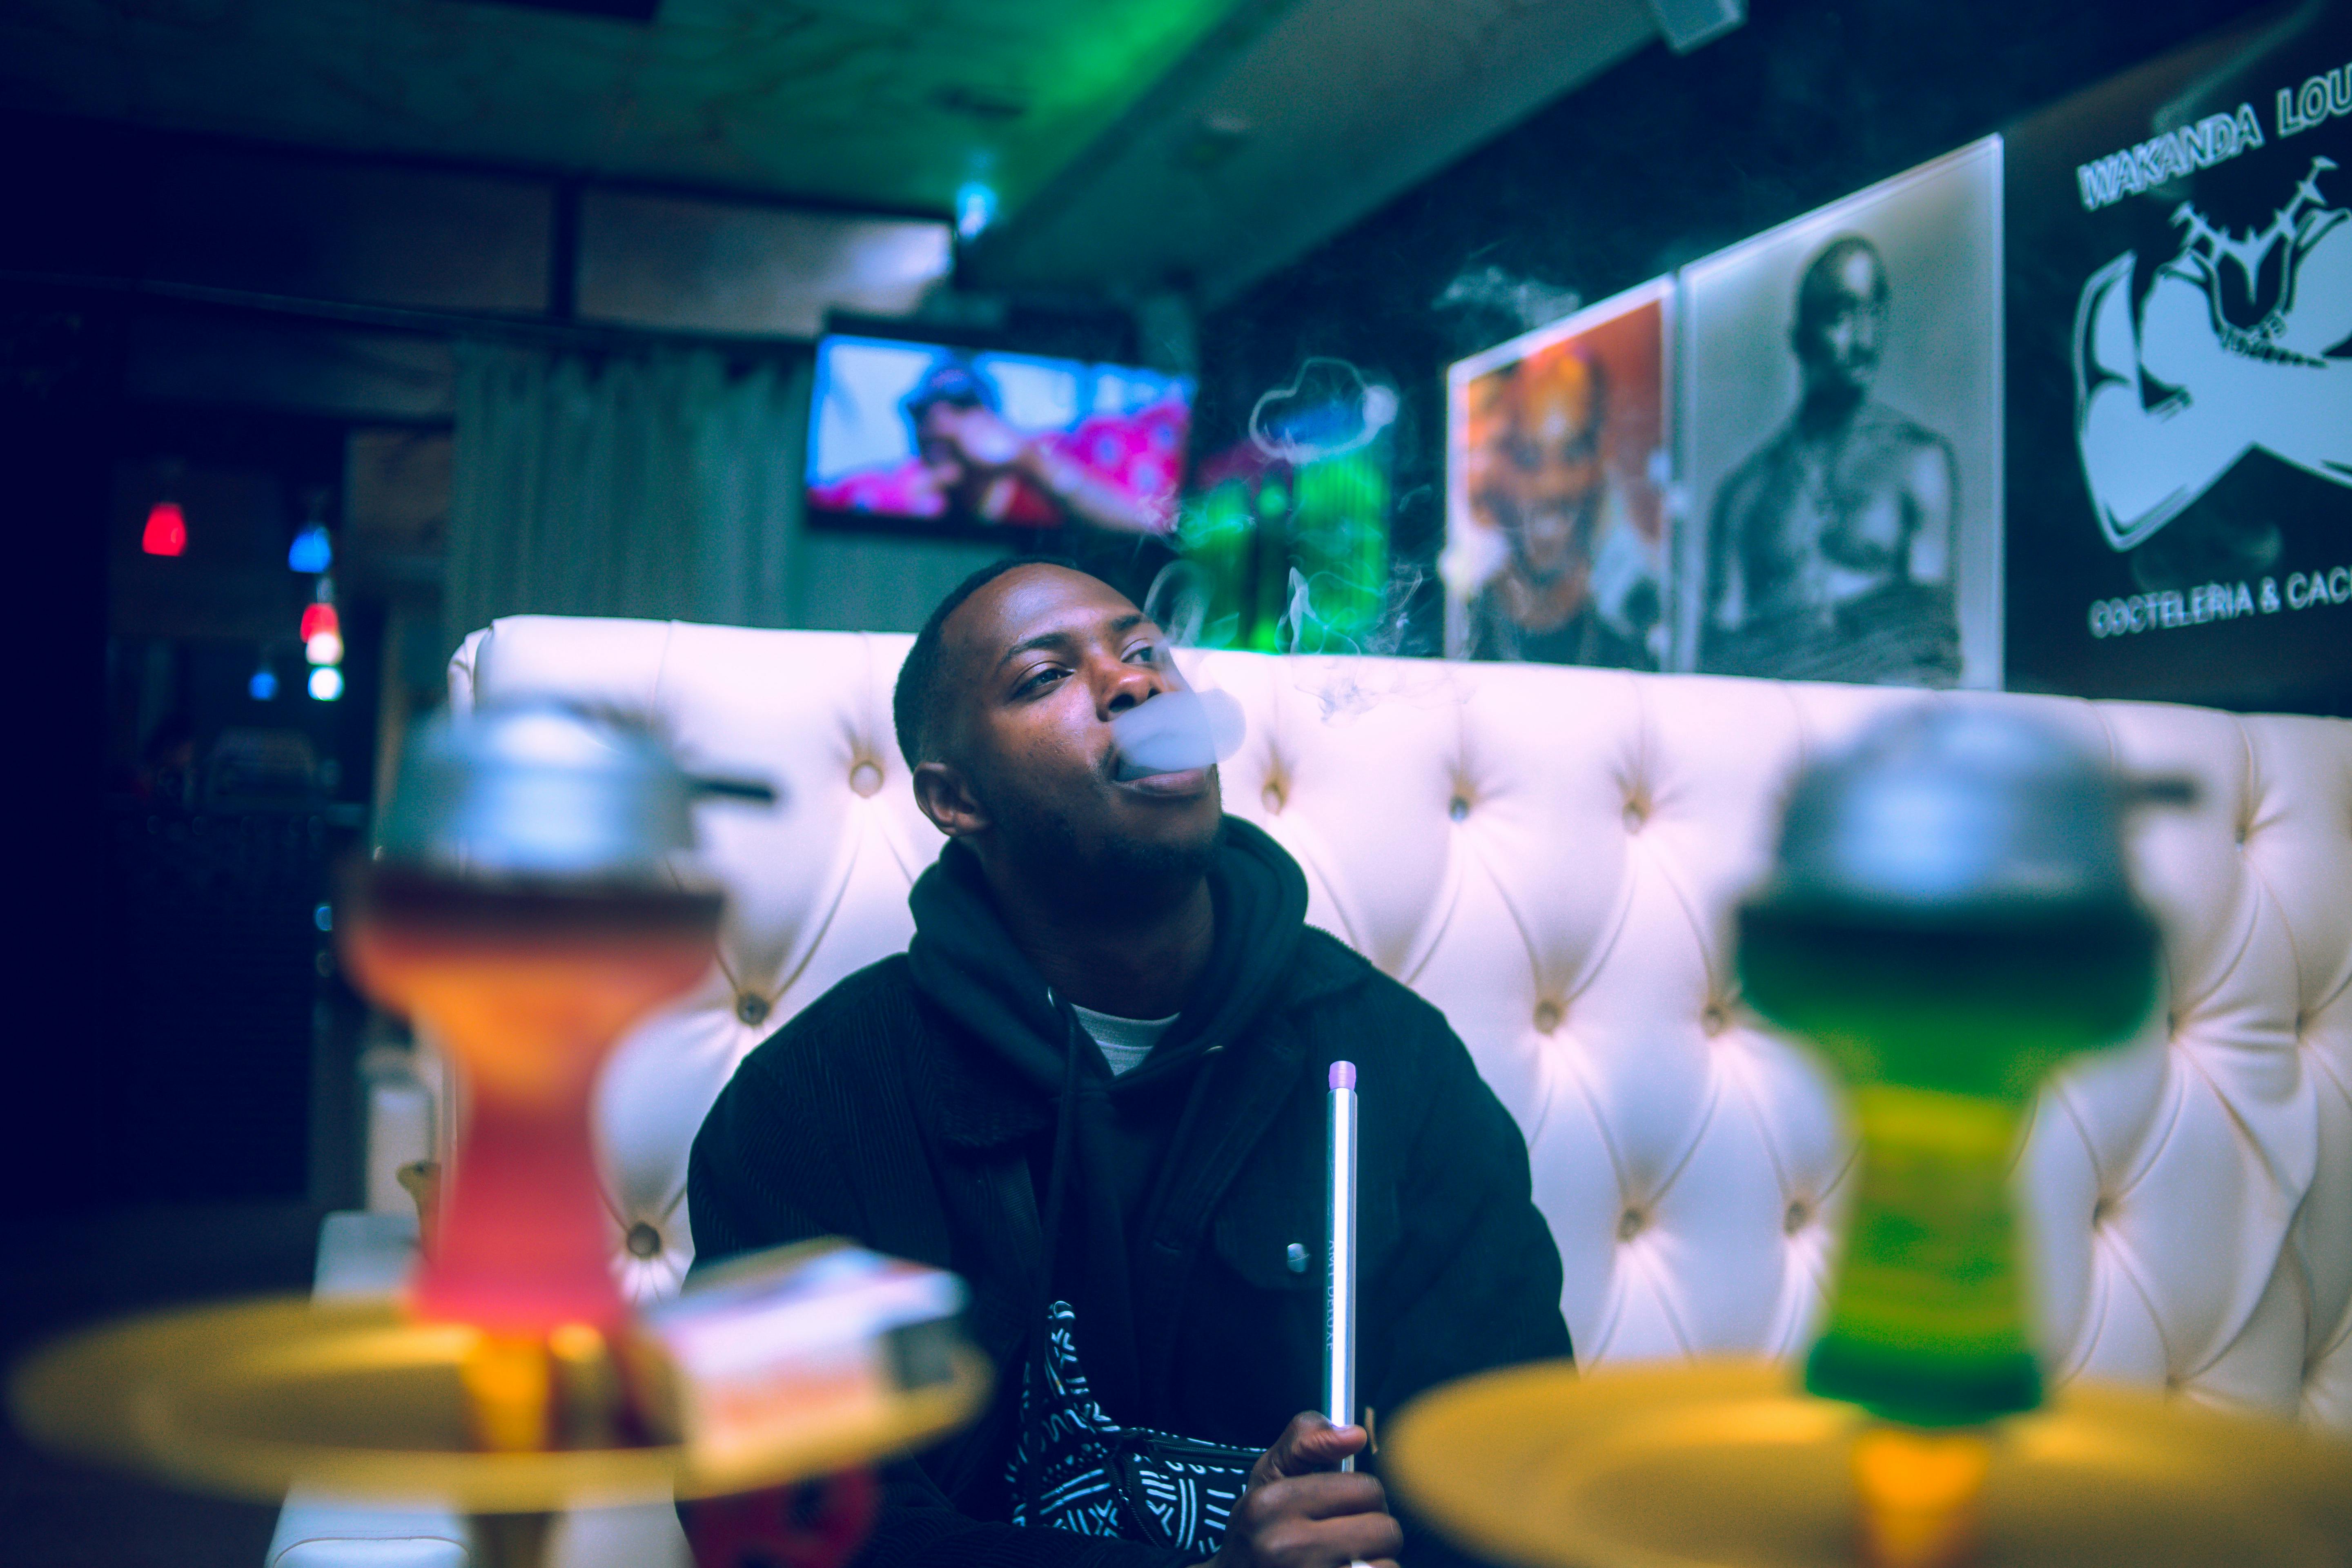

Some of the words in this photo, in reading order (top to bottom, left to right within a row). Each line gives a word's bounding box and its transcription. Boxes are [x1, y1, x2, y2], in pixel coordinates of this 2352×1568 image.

[2077, 102, 2265, 212] WAKANDA
[2276, 61, 2352, 139] LOU
[2258, 576, 2282, 614] &
[2287, 565, 2352, 610] CAC
